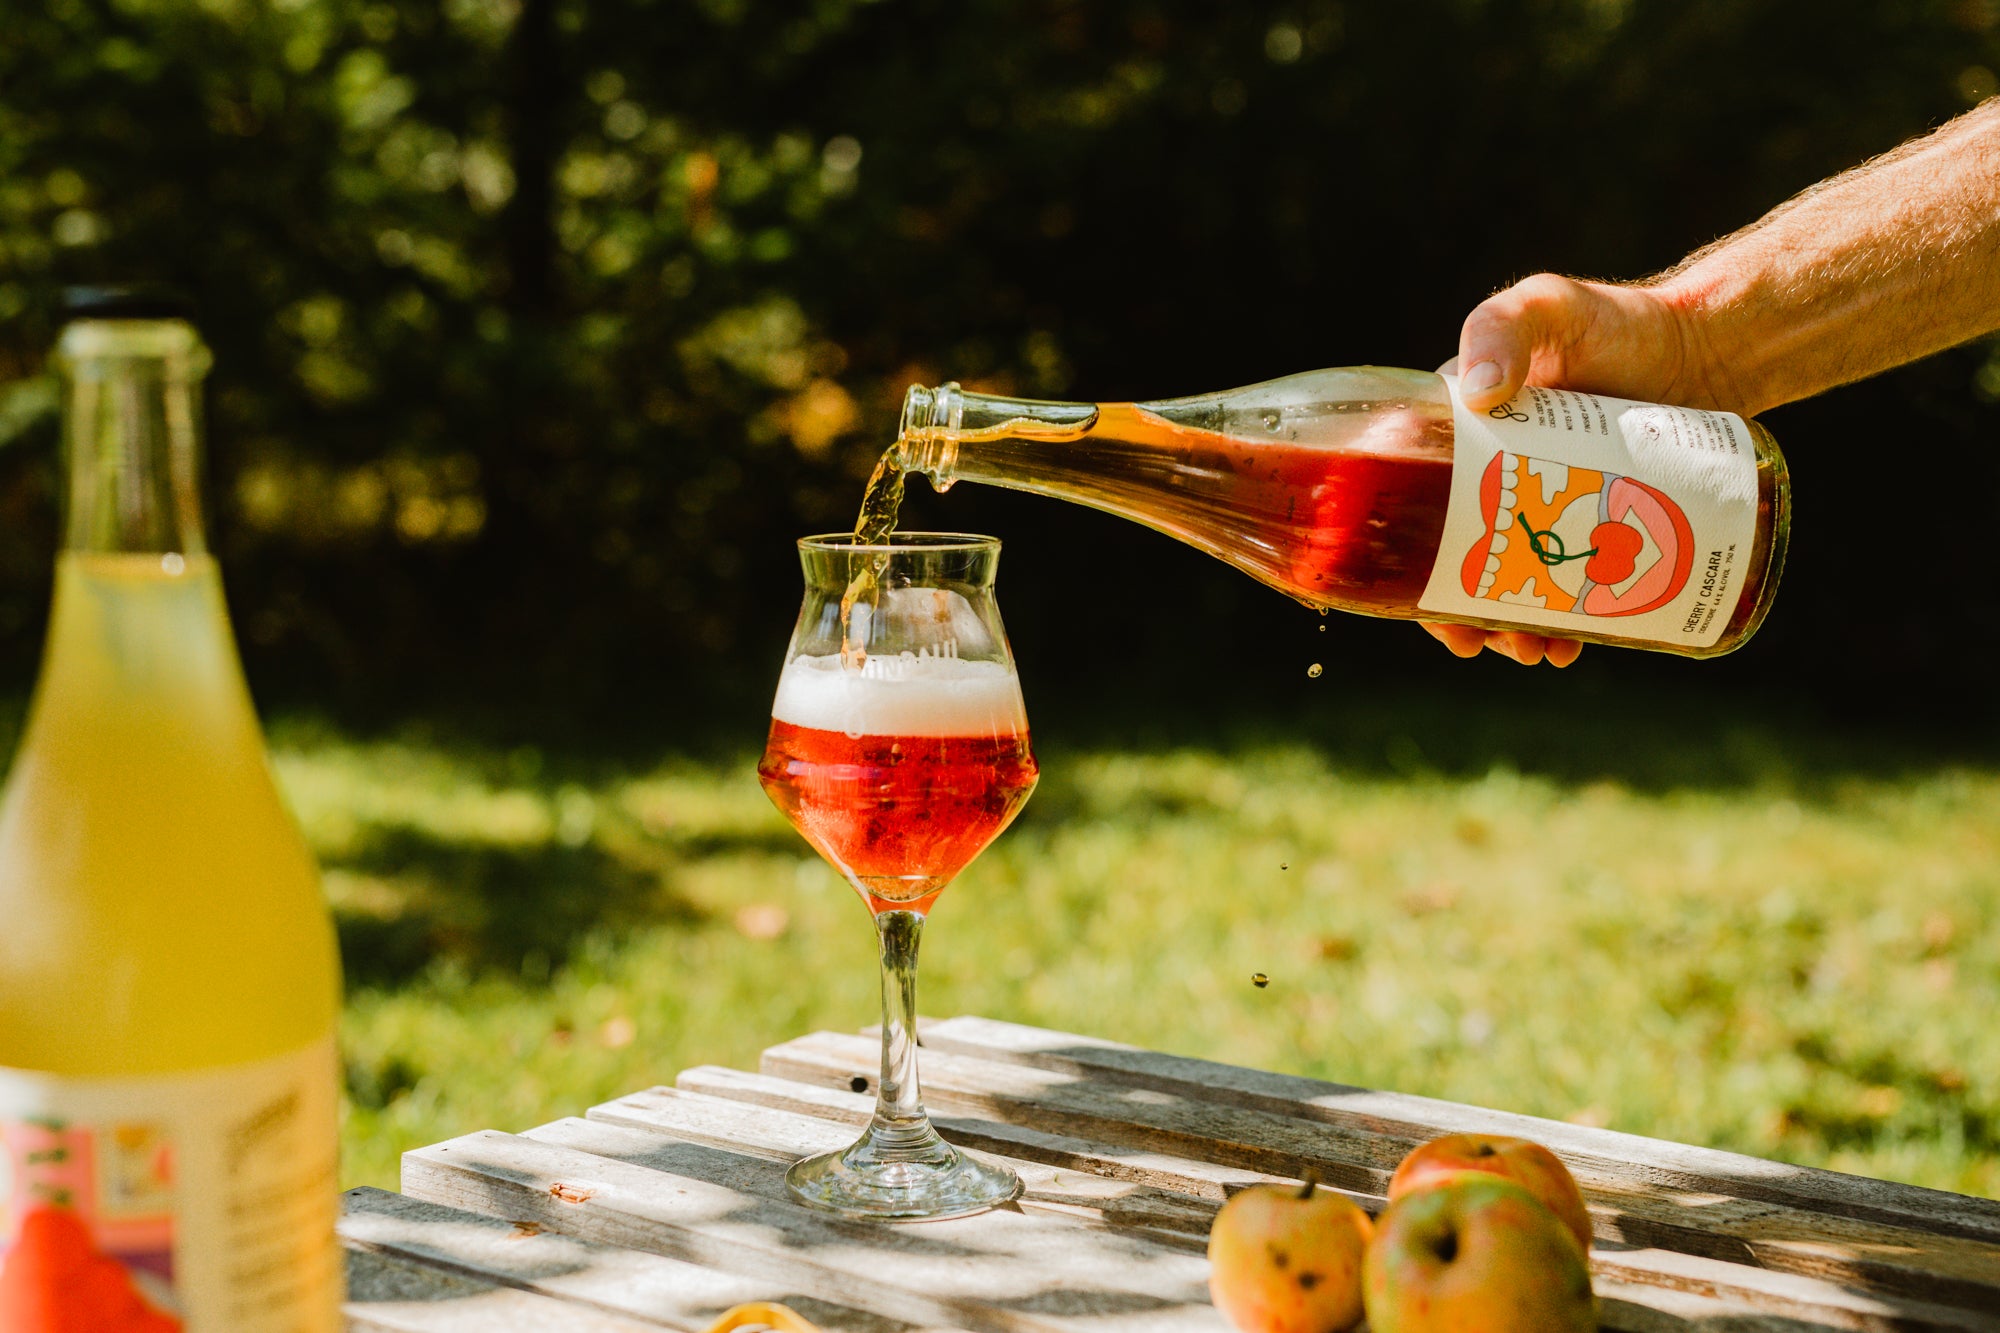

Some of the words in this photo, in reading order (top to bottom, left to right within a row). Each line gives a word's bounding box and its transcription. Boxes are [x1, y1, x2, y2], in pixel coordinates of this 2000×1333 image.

[1726, 552, 1734, 564] 750
[1682, 602, 1707, 633] CHERRY
[1700, 551, 1722, 597] CASCARA
